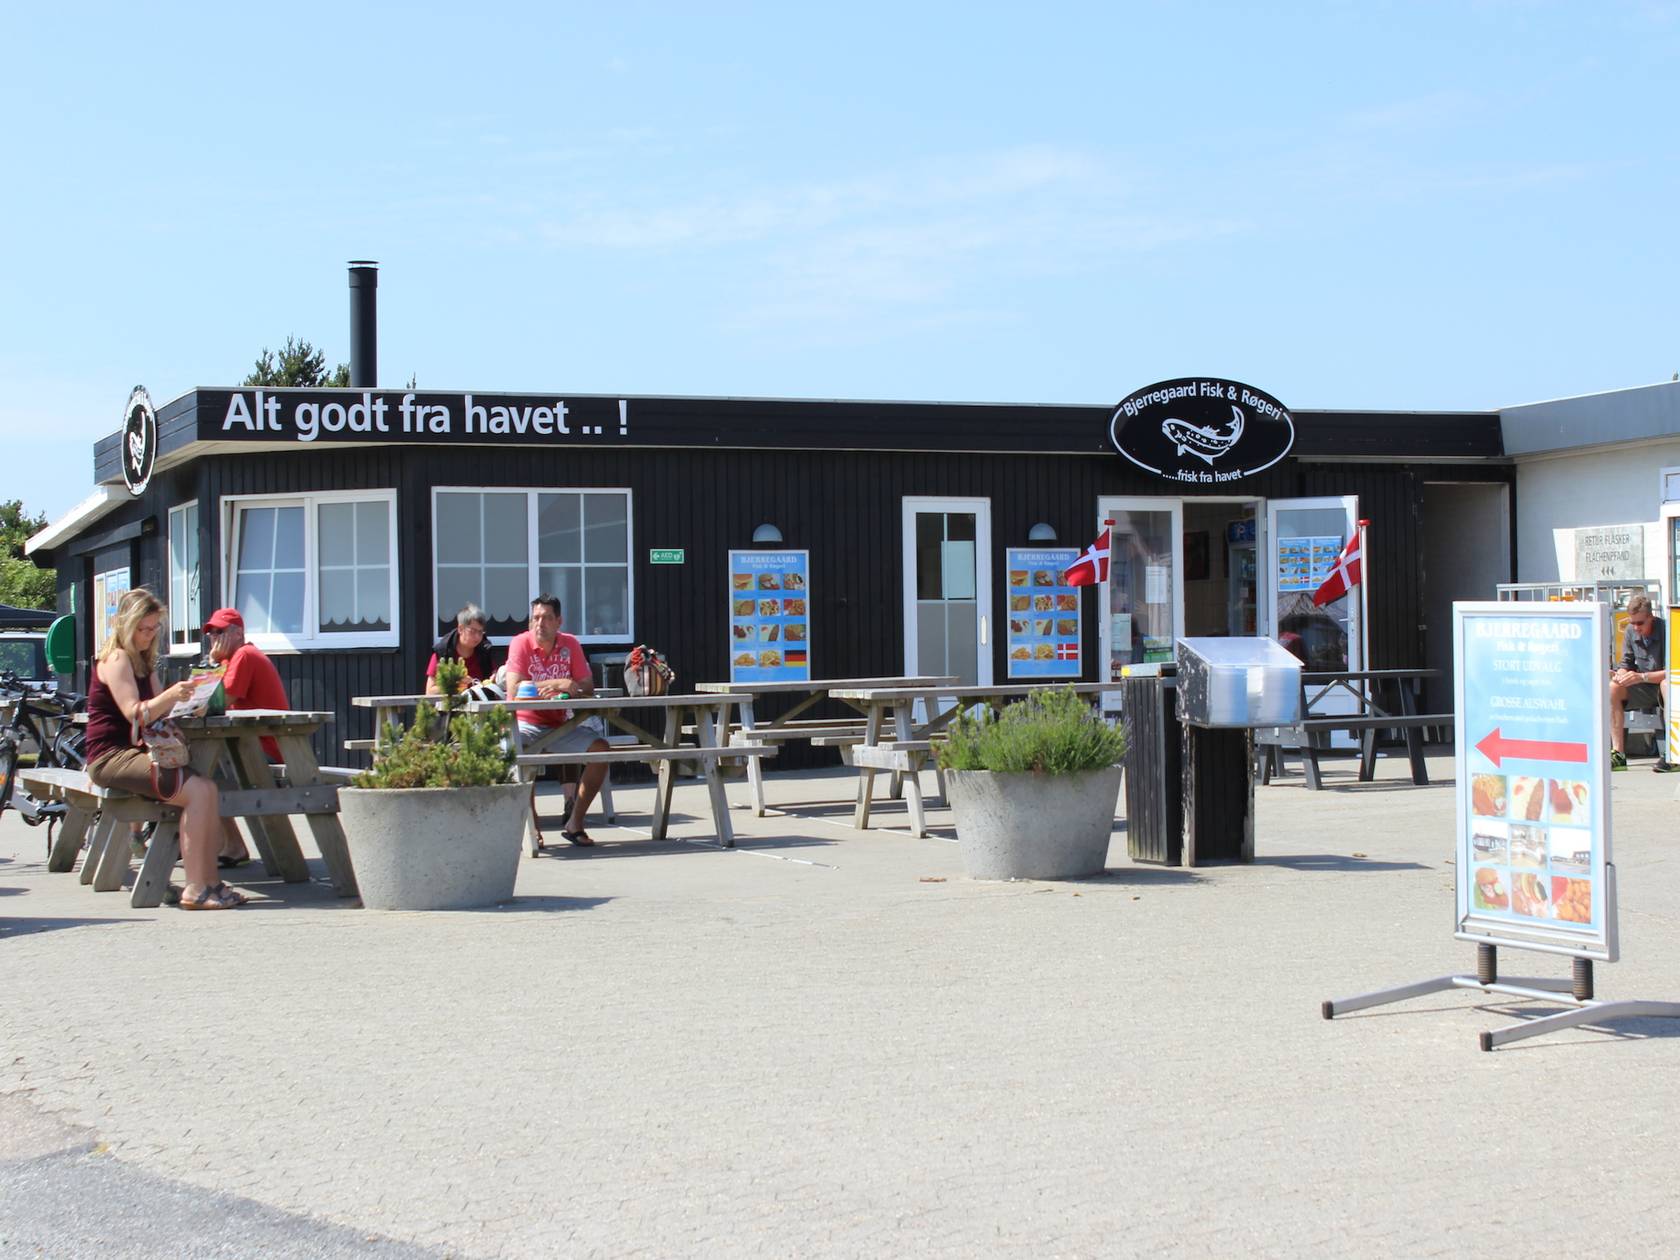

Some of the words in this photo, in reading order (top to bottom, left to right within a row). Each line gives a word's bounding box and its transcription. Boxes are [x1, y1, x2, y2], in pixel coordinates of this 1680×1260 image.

[1122, 382, 1197, 417] Bjerregaard
[1200, 382, 1224, 398] Fisk
[1227, 386, 1237, 400] &
[1241, 389, 1284, 420] Røgeri
[222, 391, 282, 431] Alt
[294, 392, 390, 442] godt
[398, 393, 450, 433] fra
[464, 394, 570, 434] havet
[1200, 469, 1213, 483] fra
[1215, 468, 1242, 483] havet
[1584, 536, 1603, 546] RETUR
[1493, 660, 1520, 671] STORT
